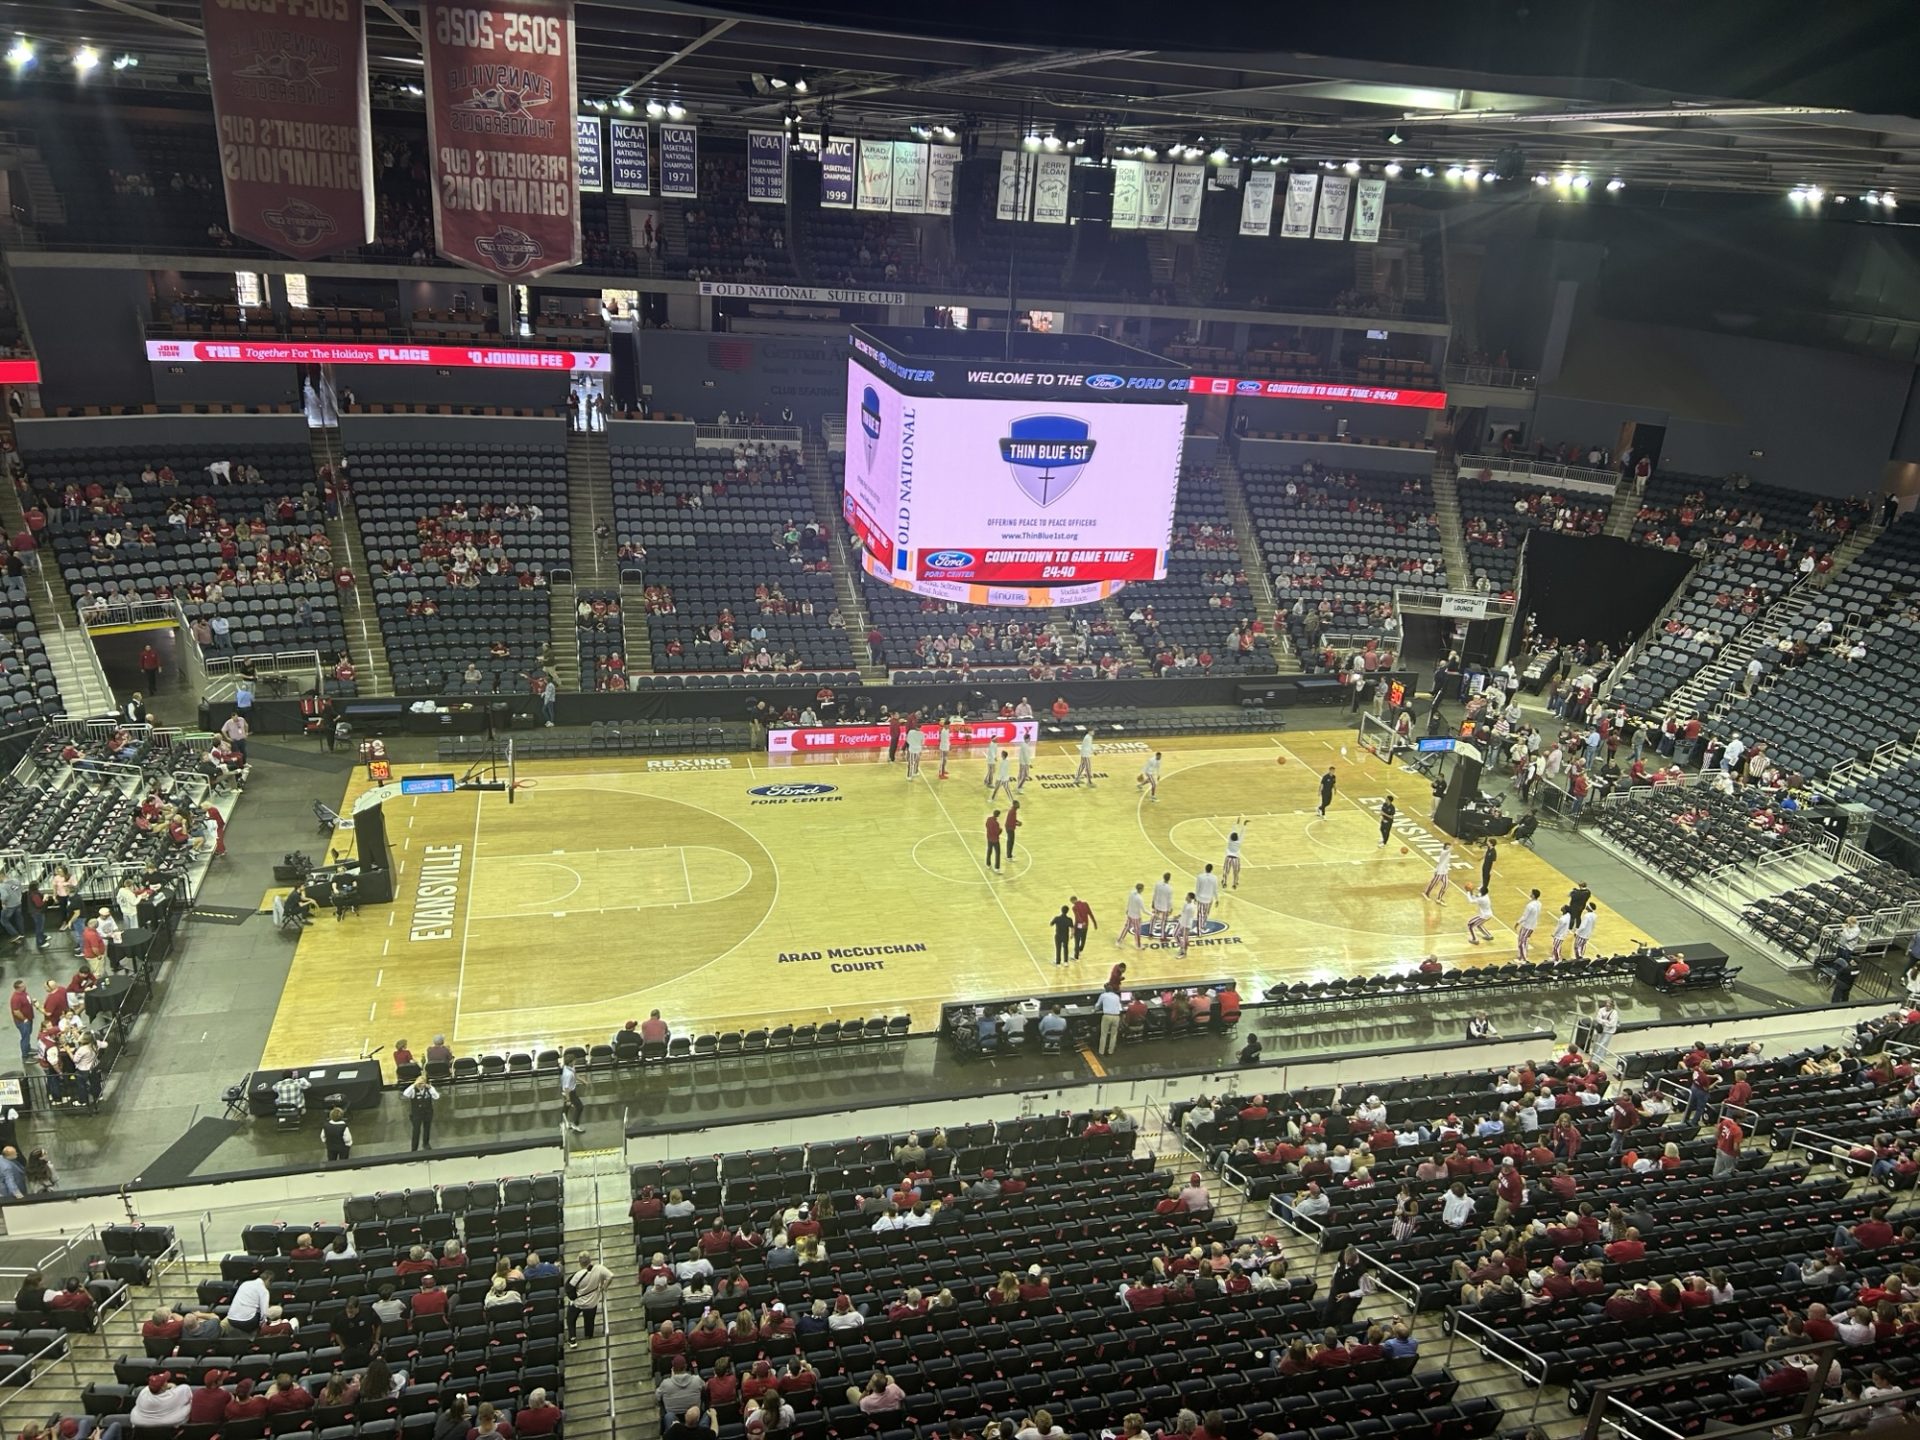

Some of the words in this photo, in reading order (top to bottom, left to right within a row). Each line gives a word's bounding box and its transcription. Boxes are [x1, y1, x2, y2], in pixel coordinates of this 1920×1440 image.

[616, 126, 644, 140] NCAA
[664, 130, 692, 144] NCAA
[614, 140, 646, 149] BASKETBALL
[663, 144, 694, 153] BASKETBALL
[752, 136, 780, 150] NCAA
[826, 143, 850, 156] MVC
[615, 158, 646, 166] CHAMPIONS
[620, 168, 642, 179] 1965
[668, 172, 690, 182] 1971
[826, 190, 847, 200] 1999
[716, 284, 744, 295] OLD
[749, 286, 816, 300] NATIONAL
[827, 290, 866, 302] SUITE
[869, 292, 903, 304] CLUB
[206, 346, 241, 358] THE
[246, 348, 290, 360] Together
[292, 349, 309, 358] For
[310, 349, 330, 358] The
[332, 349, 374, 362] Holidays
[378, 349, 430, 361] PLACE
[484, 352, 537, 366] JOINING
[541, 354, 563, 366] FEE
[967, 372, 1034, 384] WELCOME
[1036, 374, 1054, 385] TO
[1057, 375, 1083, 386] THE
[1127, 378, 1164, 390] FORD
[1267, 384, 1314, 394] COUNTDOWN
[1316, 386, 1325, 395] TO
[1327, 386, 1348, 396] GAME
[900, 408, 916, 503] NATIONAL
[1010, 444, 1035, 459] THIN
[1038, 445, 1066, 460] BLUE
[1069, 446, 1088, 460] 1ST
[898, 507, 910, 545] OLD
[936, 554, 964, 567] Ford
[985, 551, 1052, 562] COUNTDOWN
[1054, 552, 1067, 562] TO
[1071, 552, 1100, 562] GAME
[1103, 552, 1135, 562] TIME:
[1042, 566, 1075, 578] 24:40
[805, 734, 835, 746] THE
[839, 733, 877, 745] Together
[880, 733, 892, 742] Fo
[647, 758, 731, 768] REXING
[766, 785, 819, 796] Ford
[409, 844, 464, 942] EVANSVILLE
[778, 951, 822, 963] ARAD
[831, 961, 884, 974] COURT
